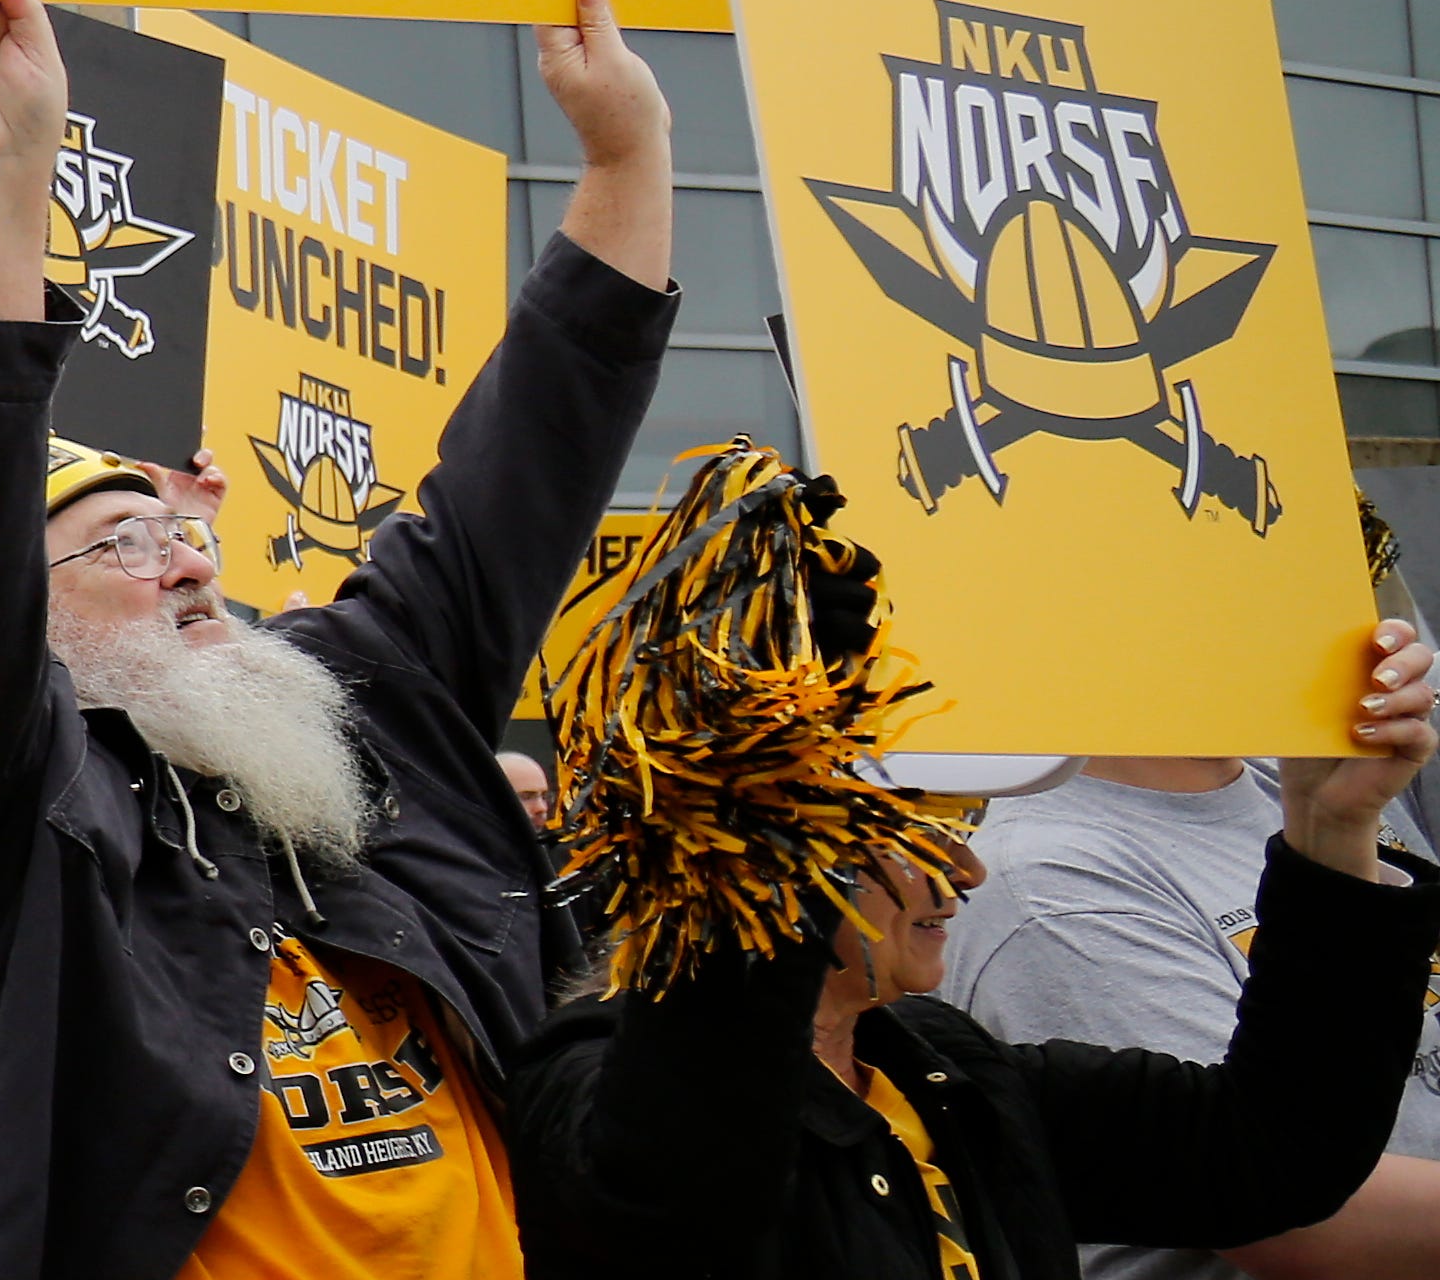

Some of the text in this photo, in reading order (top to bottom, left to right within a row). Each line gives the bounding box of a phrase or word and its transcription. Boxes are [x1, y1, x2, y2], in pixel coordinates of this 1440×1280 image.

[947, 16, 1087, 91] NKU
[223, 79, 409, 256] TICKET
[899, 72, 1182, 254] NORSE
[302, 379, 351, 418] NKU
